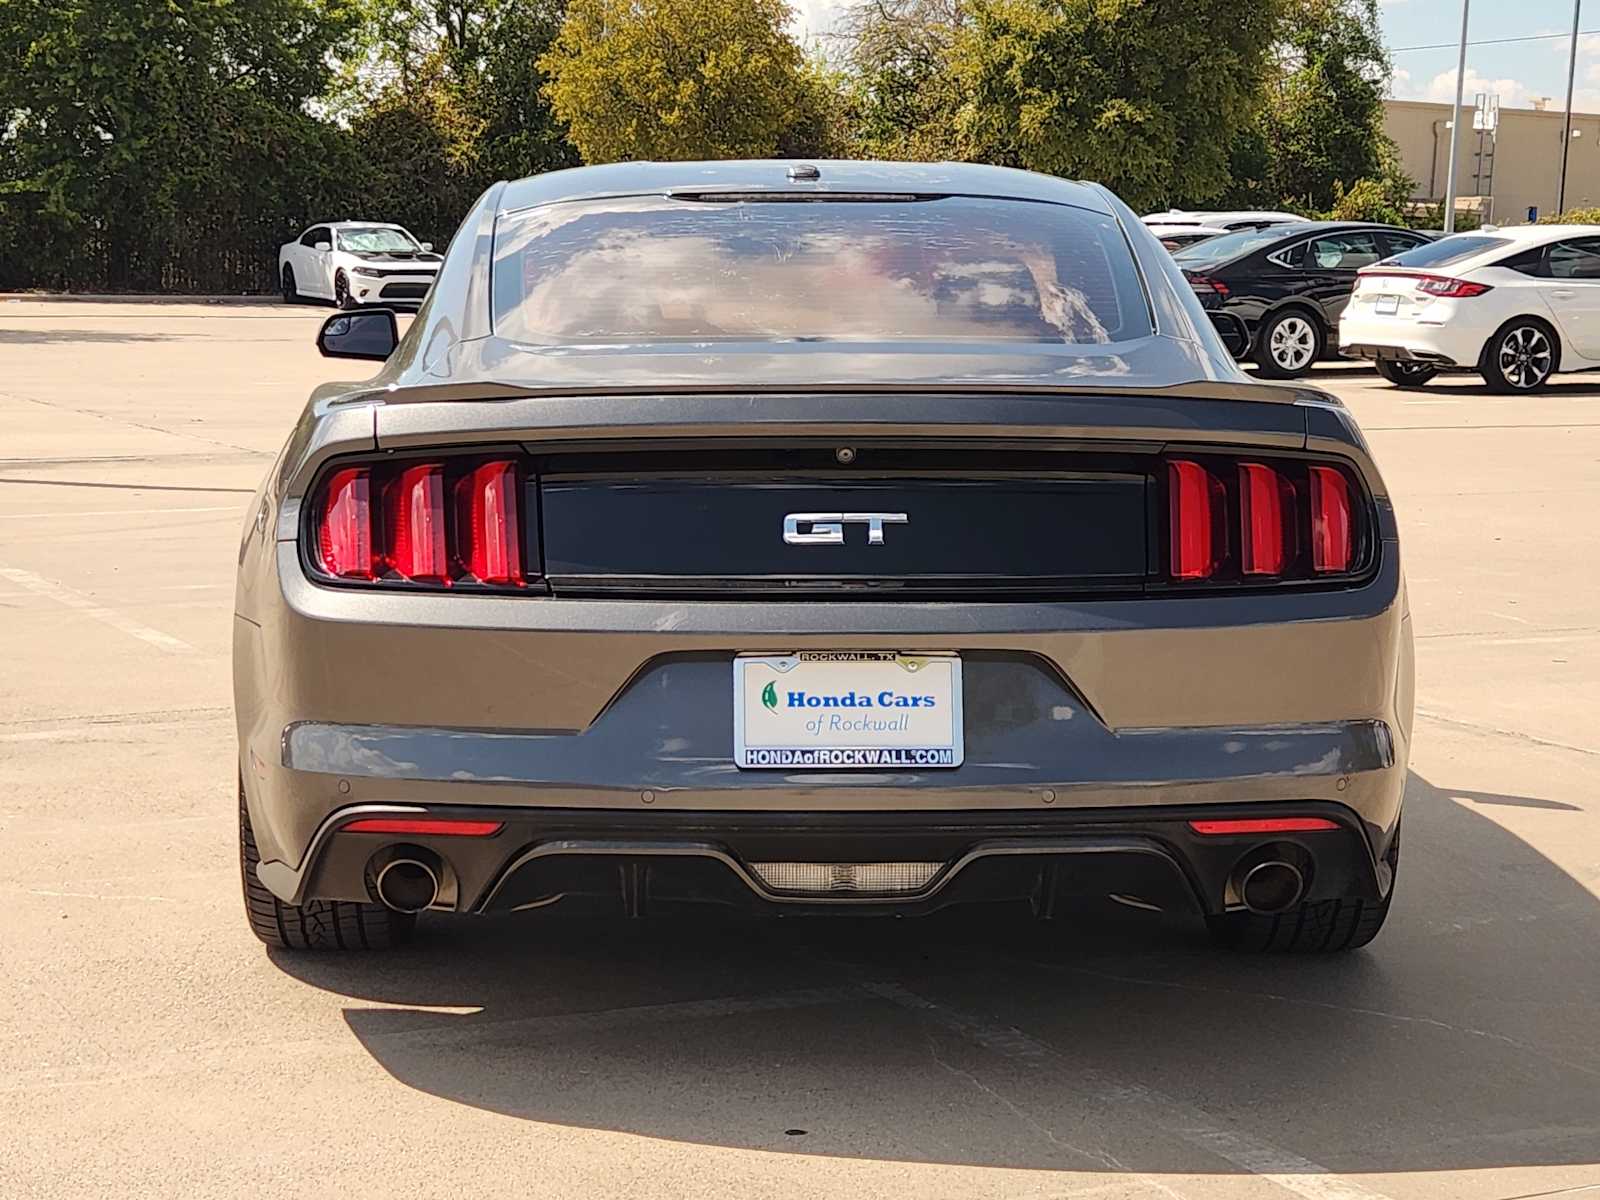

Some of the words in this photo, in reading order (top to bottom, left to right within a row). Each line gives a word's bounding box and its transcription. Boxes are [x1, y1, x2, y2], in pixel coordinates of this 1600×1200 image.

[783, 513, 908, 544] GT
[787, 692, 873, 708] Honda
[878, 692, 935, 708] Cars
[806, 714, 825, 736] of
[829, 714, 909, 731] Rockwall
